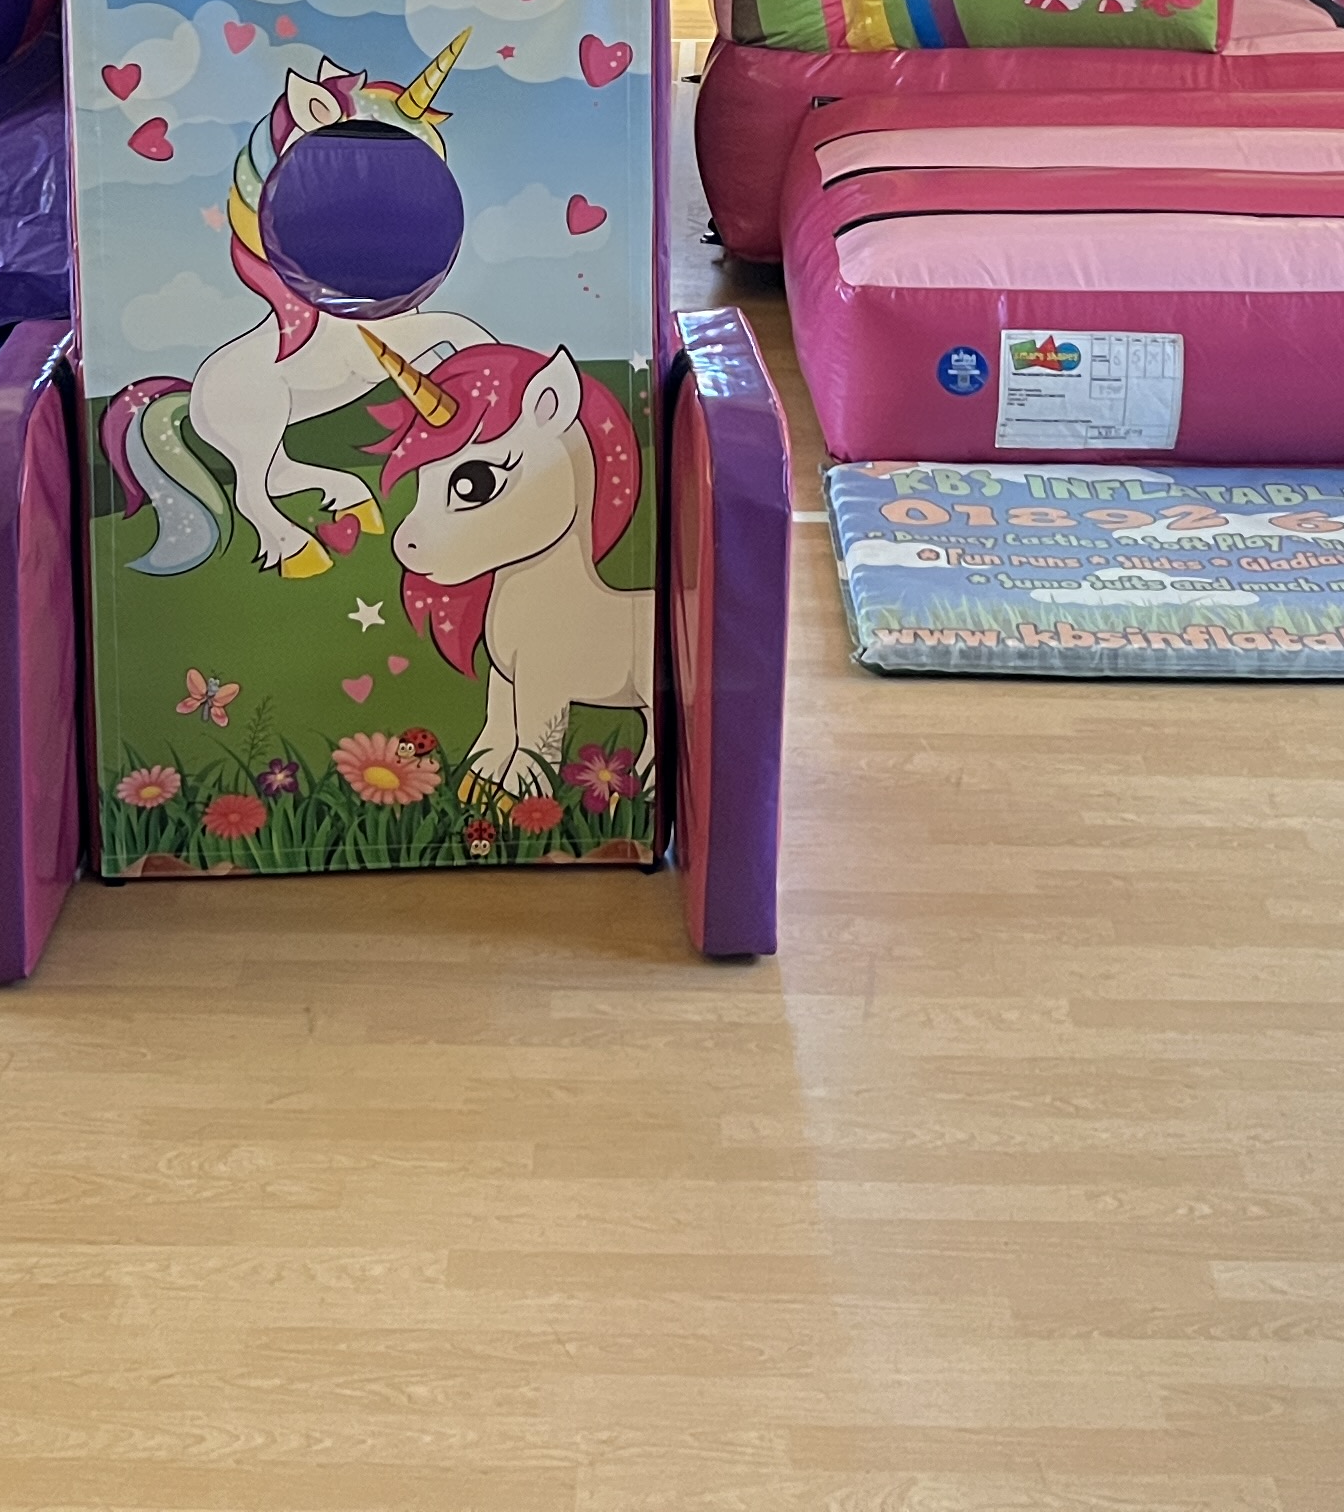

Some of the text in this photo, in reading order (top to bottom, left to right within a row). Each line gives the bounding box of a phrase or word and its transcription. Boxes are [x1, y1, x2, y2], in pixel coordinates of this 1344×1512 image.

[891, 468, 1002, 497] KBS
[880, 497, 1229, 530] 01892
[893, 531, 997, 548] Bouncy
[1003, 533, 1110, 549] Castles
[1143, 536, 1209, 551] Soft
[1212, 533, 1283, 552] Play
[946, 548, 1003, 567] Fun
[1009, 553, 1083, 569] runs
[1112, 554, 1205, 571] Slides
[995, 573, 1082, 589] Sumo
[1082, 575, 1166, 591] Suits
[1170, 577, 1232, 592] and
[1239, 576, 1324, 593] much
